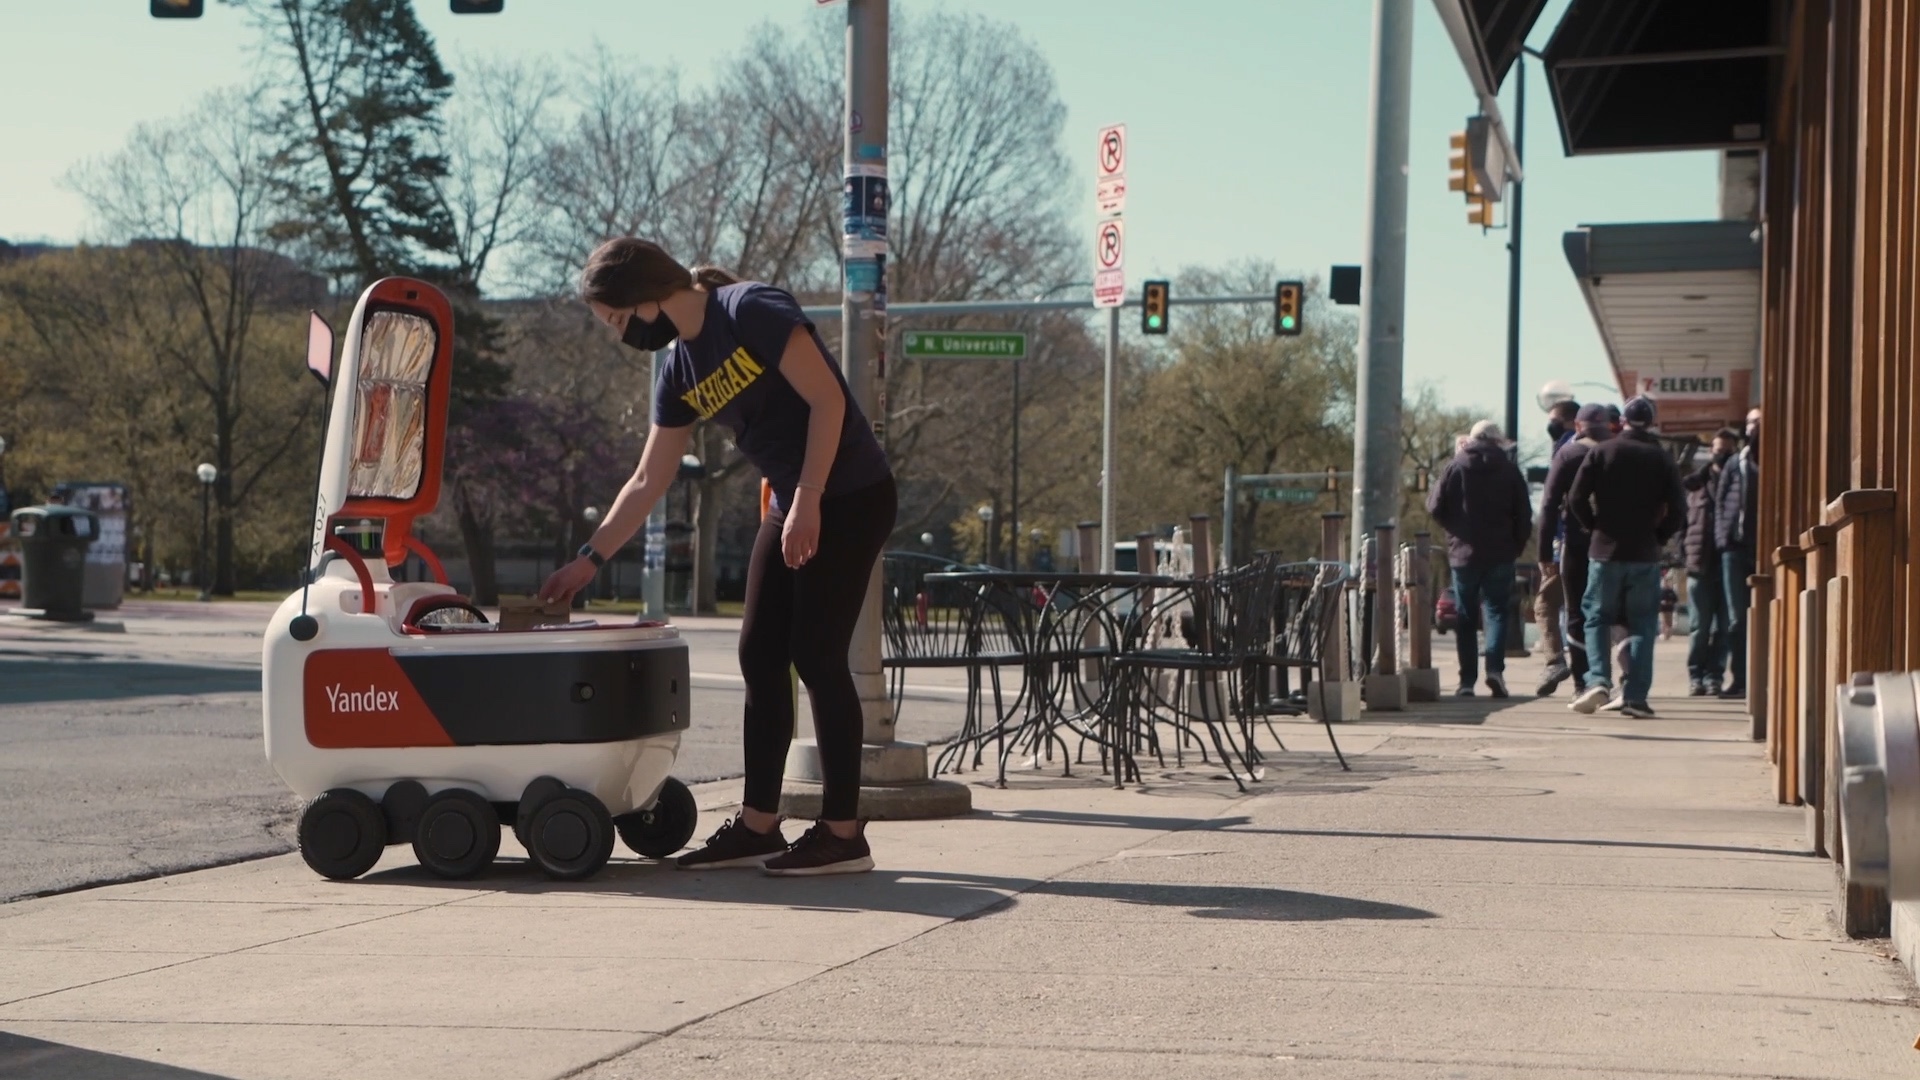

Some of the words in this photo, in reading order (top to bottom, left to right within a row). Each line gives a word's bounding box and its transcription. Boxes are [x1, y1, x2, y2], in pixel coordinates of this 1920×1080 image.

[924, 337, 938, 351] N.
[942, 337, 1017, 355] University
[312, 493, 326, 556] A-027
[325, 682, 399, 713] Yandex
